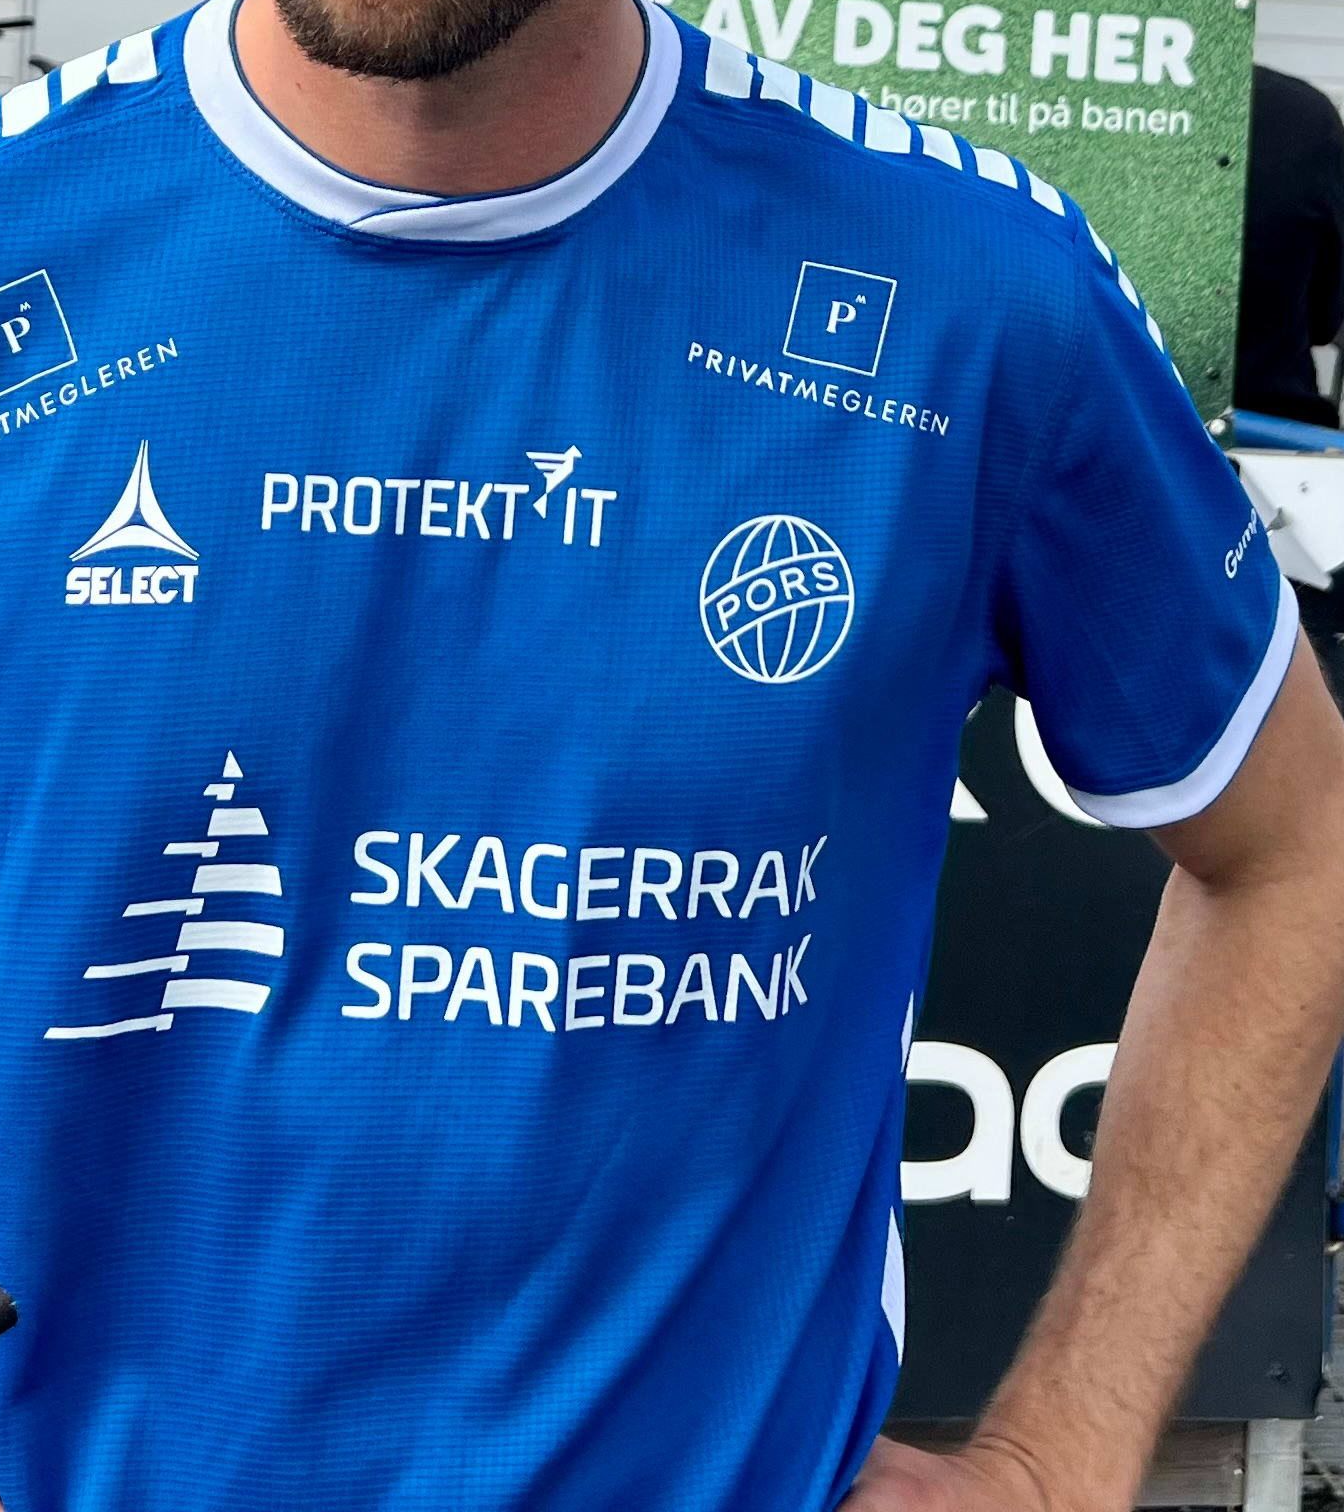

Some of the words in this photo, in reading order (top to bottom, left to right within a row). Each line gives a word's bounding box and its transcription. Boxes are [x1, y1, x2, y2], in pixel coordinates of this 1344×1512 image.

[1030, 9, 1196, 88] HER
[986, 93, 1020, 126] til
[1027, 95, 1073, 135] på
[1081, 98, 1191, 137] banen
[687, 342, 950, 436] PRIVATMEGLEREN
[260, 472, 530, 541] PROTEKT
[562, 487, 618, 548] IT
[65, 565, 199, 605] SELECT
[716, 561, 840, 632] PORS
[350, 830, 828, 922] SKAGERRAK
[340, 934, 813, 1033] SPAREBANK
